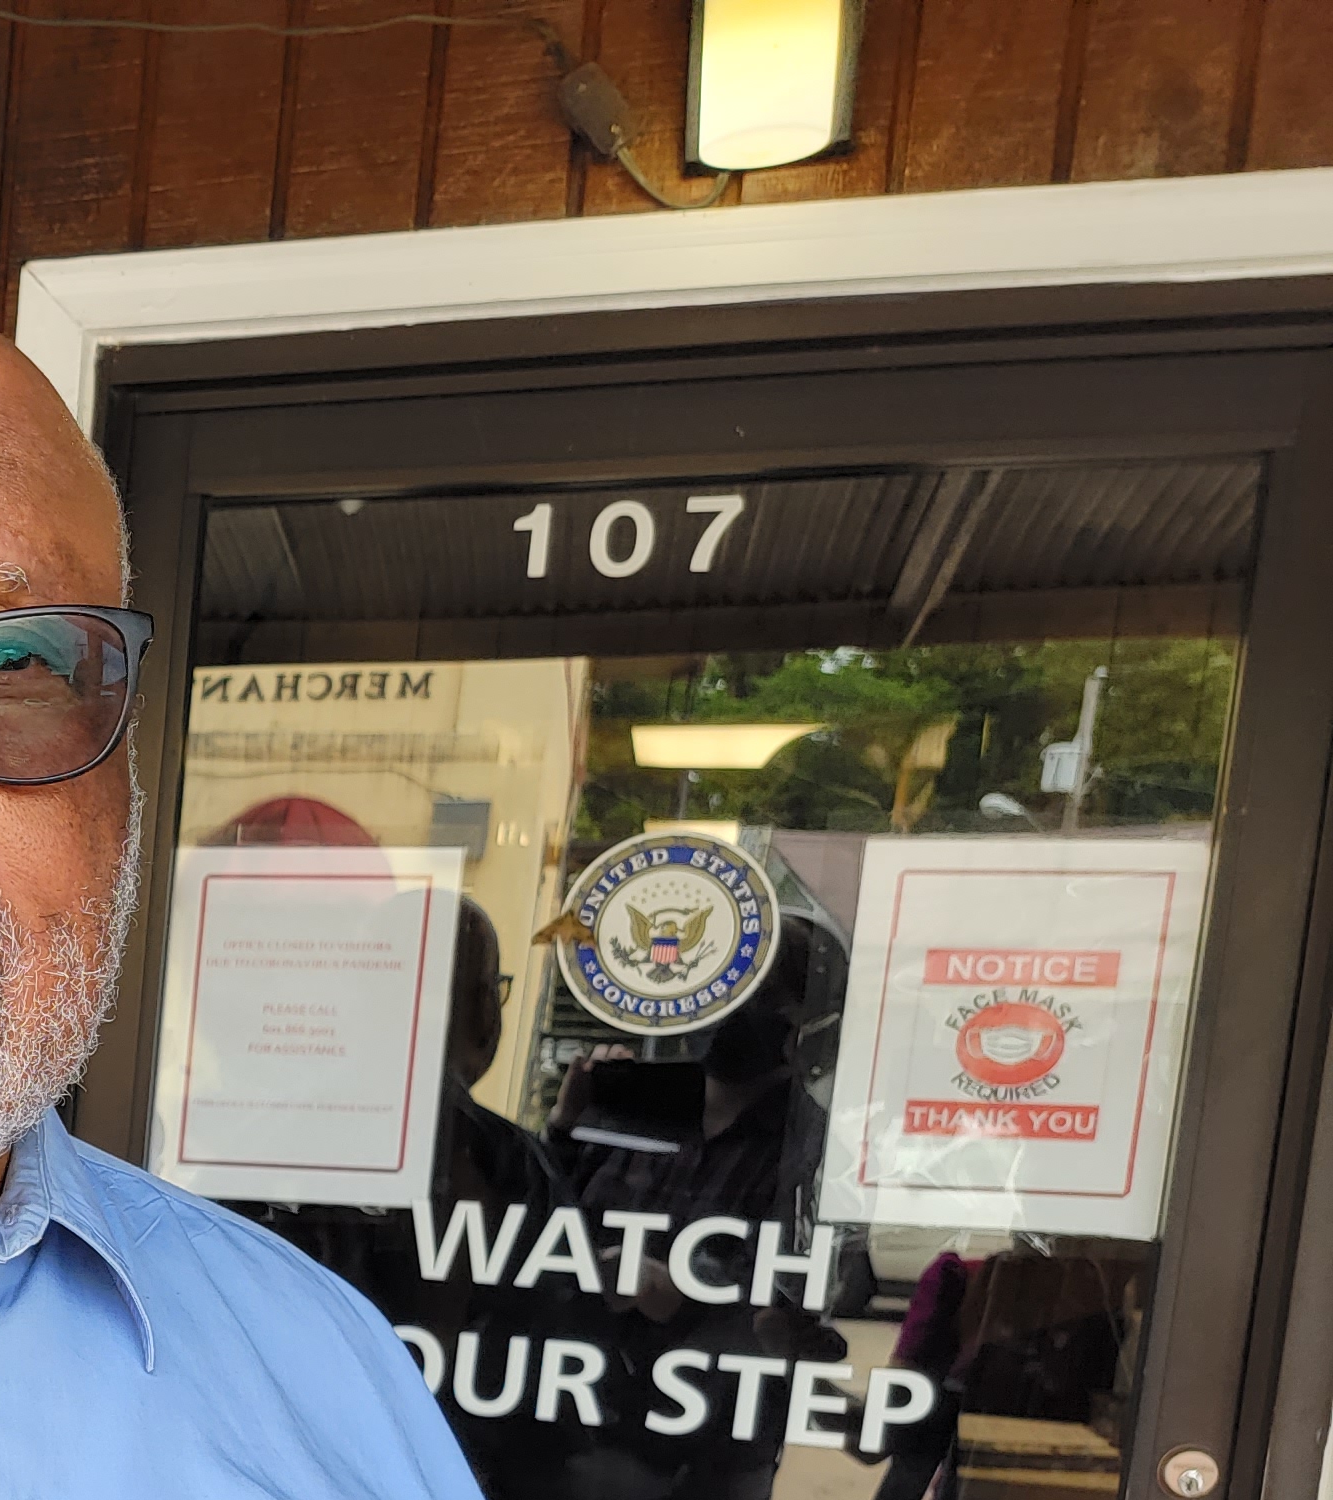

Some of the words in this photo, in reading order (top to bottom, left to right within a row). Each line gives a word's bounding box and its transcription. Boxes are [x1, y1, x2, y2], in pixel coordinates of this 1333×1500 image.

[512, 494, 744, 579] 107
[580, 848, 669, 927] UNITED
[689, 849, 761, 936] STATES
[946, 954, 1099, 983] NOTICE
[592, 972, 729, 1018] CONGRESS
[945, 988, 1008, 1032] FACE
[1019, 988, 1084, 1034] MASK
[950, 1071, 1061, 1103] REQUIRED
[908, 1106, 1018, 1131] THANK
[1029, 1110, 1096, 1135] YOU
[411, 1199, 833, 1312] WATCH
[393, 1324, 604, 1427] OUR
[644, 1348, 934, 1454] STEP
